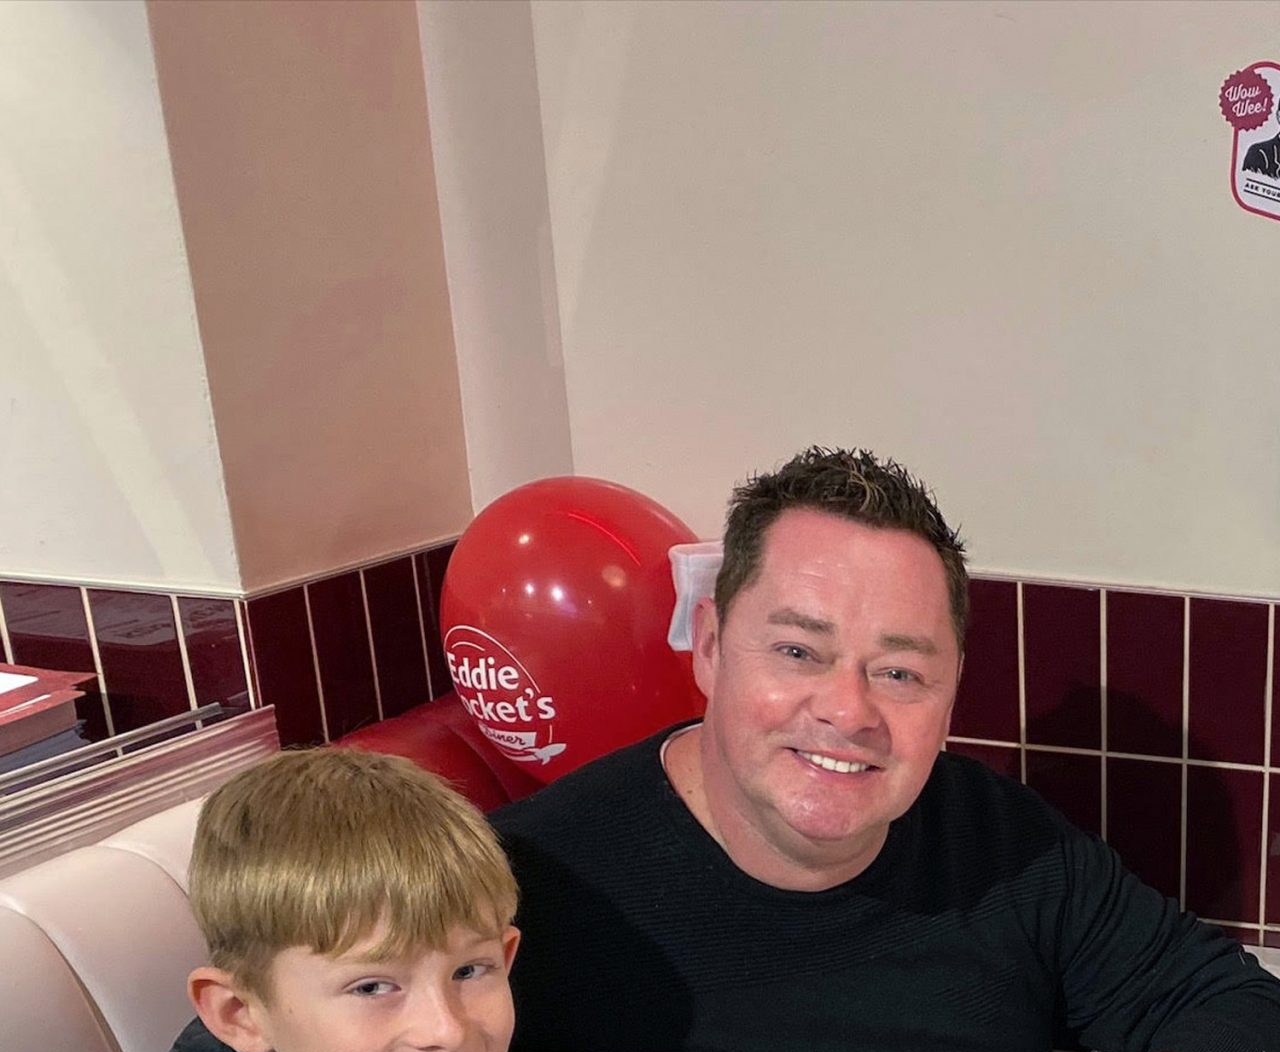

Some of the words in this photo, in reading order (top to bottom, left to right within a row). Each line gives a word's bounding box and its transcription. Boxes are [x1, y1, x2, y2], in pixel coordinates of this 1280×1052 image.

[1225, 84, 1261, 101] Wow
[1232, 98, 1268, 117] Wee!
[1245, 182, 1259, 192] ASK
[447, 652, 519, 690] Eddie
[460, 688, 556, 723] ocket's
